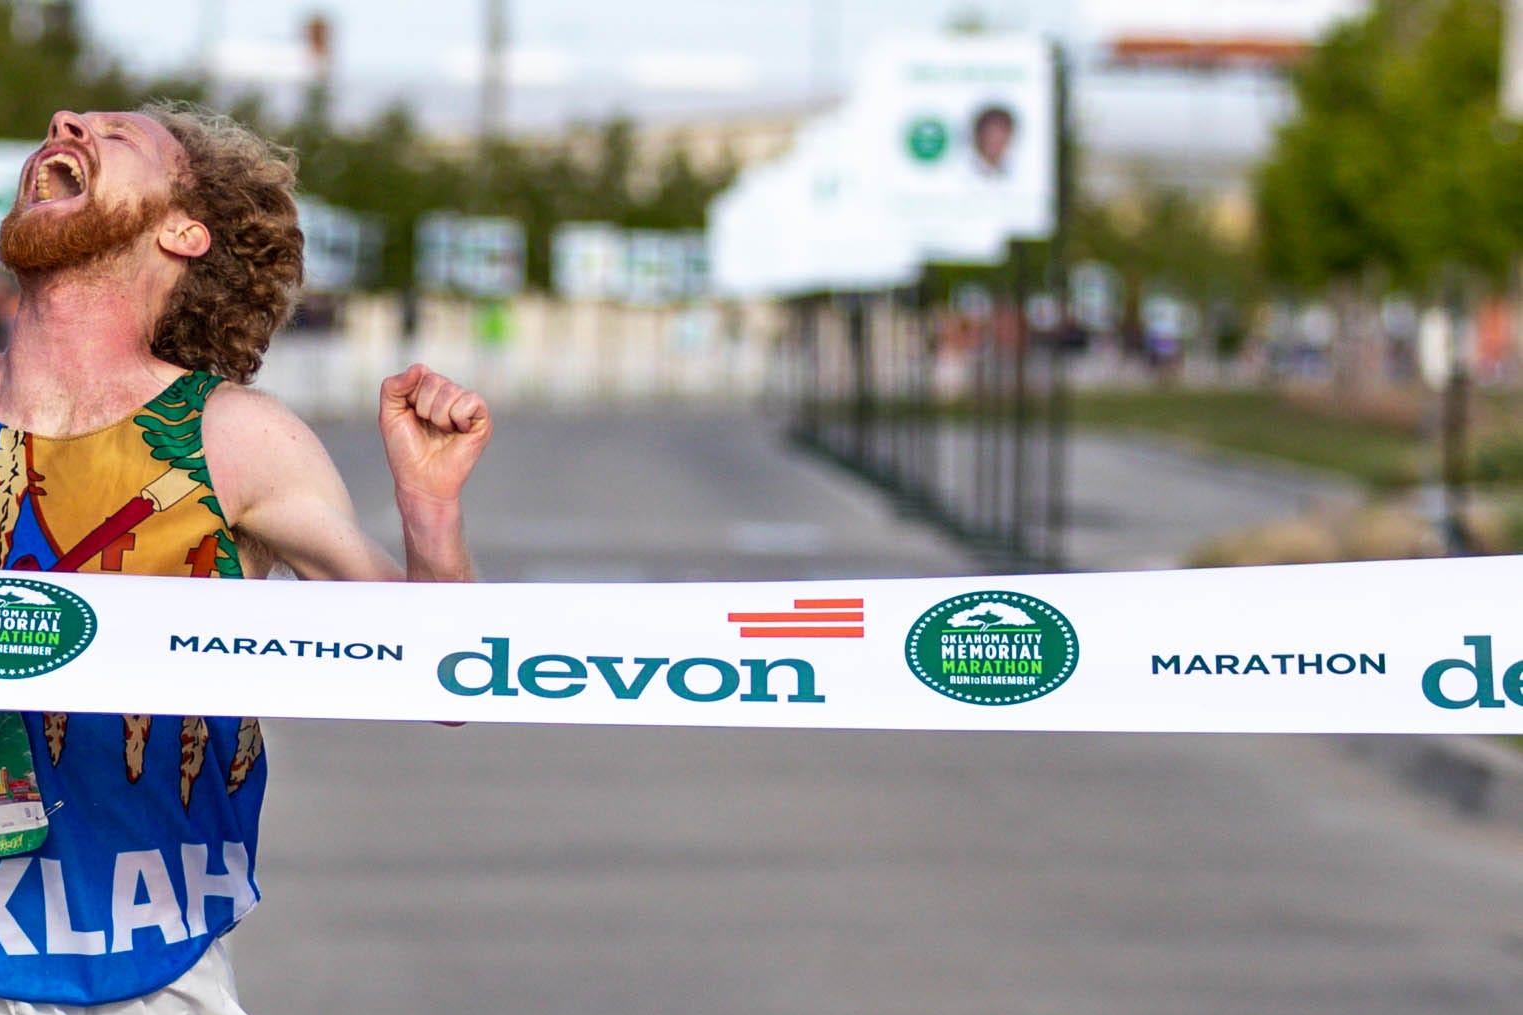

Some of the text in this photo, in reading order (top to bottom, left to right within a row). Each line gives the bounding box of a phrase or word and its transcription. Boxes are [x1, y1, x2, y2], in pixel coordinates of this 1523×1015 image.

[33, 610, 62, 620] CITY
[941, 633, 1042, 644] OKLAHOMA CITY
[169, 635, 403, 661] MARATHON
[941, 644, 1043, 659] MEMORIAL
[436, 636, 826, 703] devon
[942, 660, 1043, 674] MARATHON
[1151, 653, 1386, 675] MARATHON
[1421, 635, 1523, 709] d
